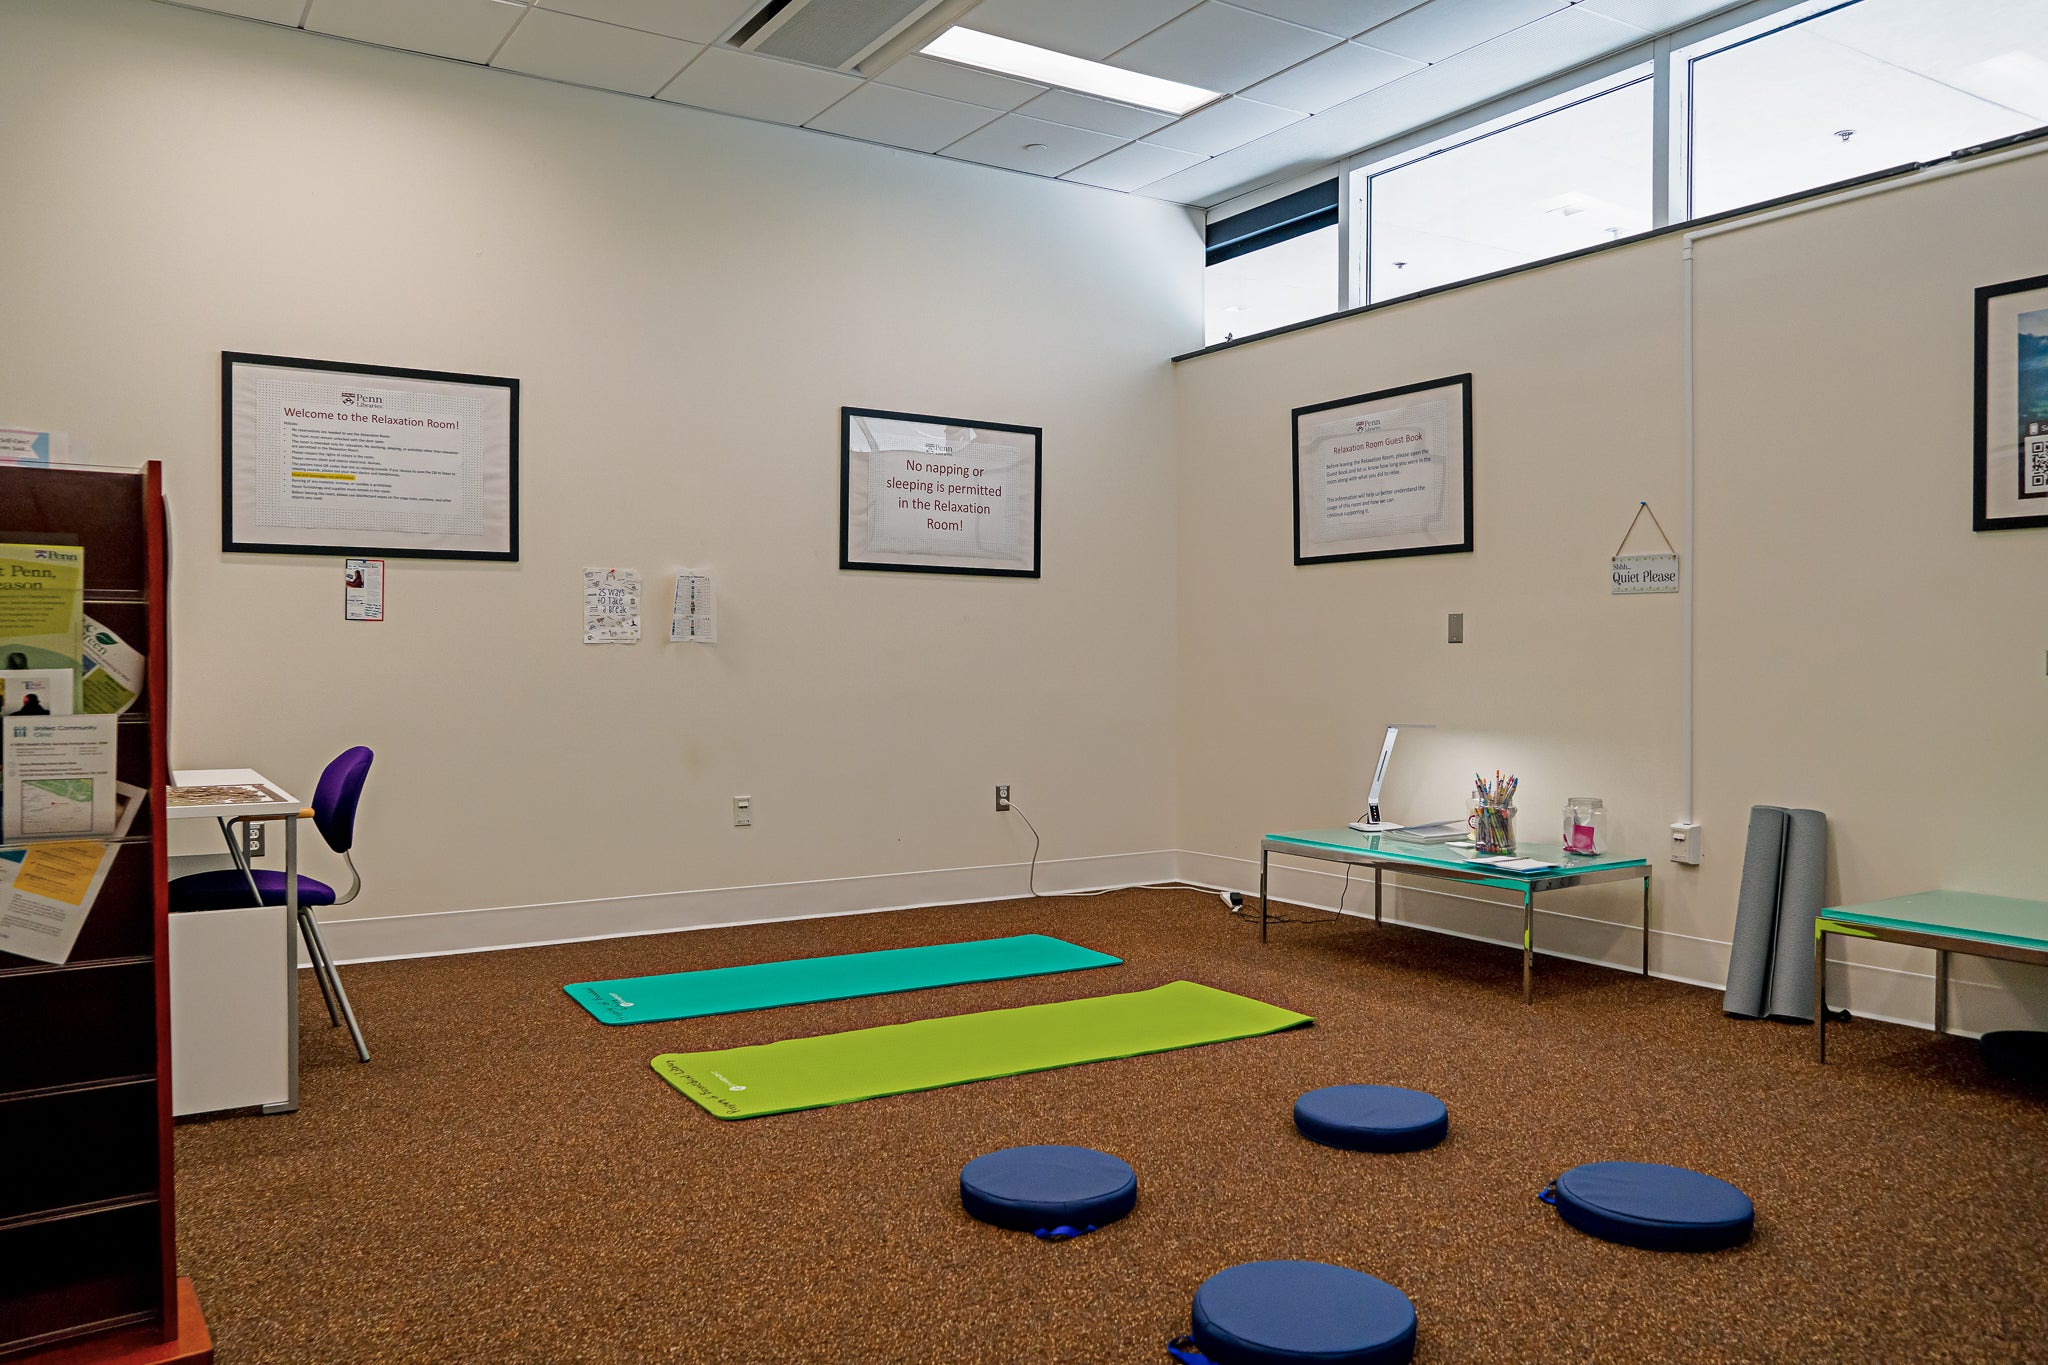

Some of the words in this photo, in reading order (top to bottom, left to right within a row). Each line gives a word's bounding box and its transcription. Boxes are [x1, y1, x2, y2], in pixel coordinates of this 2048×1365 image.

[357, 394, 382, 403] Penn
[284, 408, 334, 419] Welcome
[351, 413, 368, 422] the
[372, 415, 423, 426] Relaxation
[428, 419, 459, 429] Room!
[1334, 444, 1364, 454] Relaxation
[1366, 440, 1383, 449] Room
[1385, 437, 1403, 445] Guest
[1406, 432, 1422, 442] Book
[906, 460, 922, 471] No
[926, 464, 969, 478] napping
[973, 468, 984, 477] or
[887, 477, 933, 494] sleeping
[937, 481, 944, 492] is
[948, 485, 1001, 496] permitted
[899, 497, 908, 508] in
[912, 498, 930, 510] the
[934, 500, 990, 514] Relaxation
[927, 519, 963, 531] Room!
[48, 550, 78, 560] Penn
[11, 565, 56, 579] Penn,
[1613, 571, 1639, 585] Quiet
[1643, 570, 1675, 582] Please
